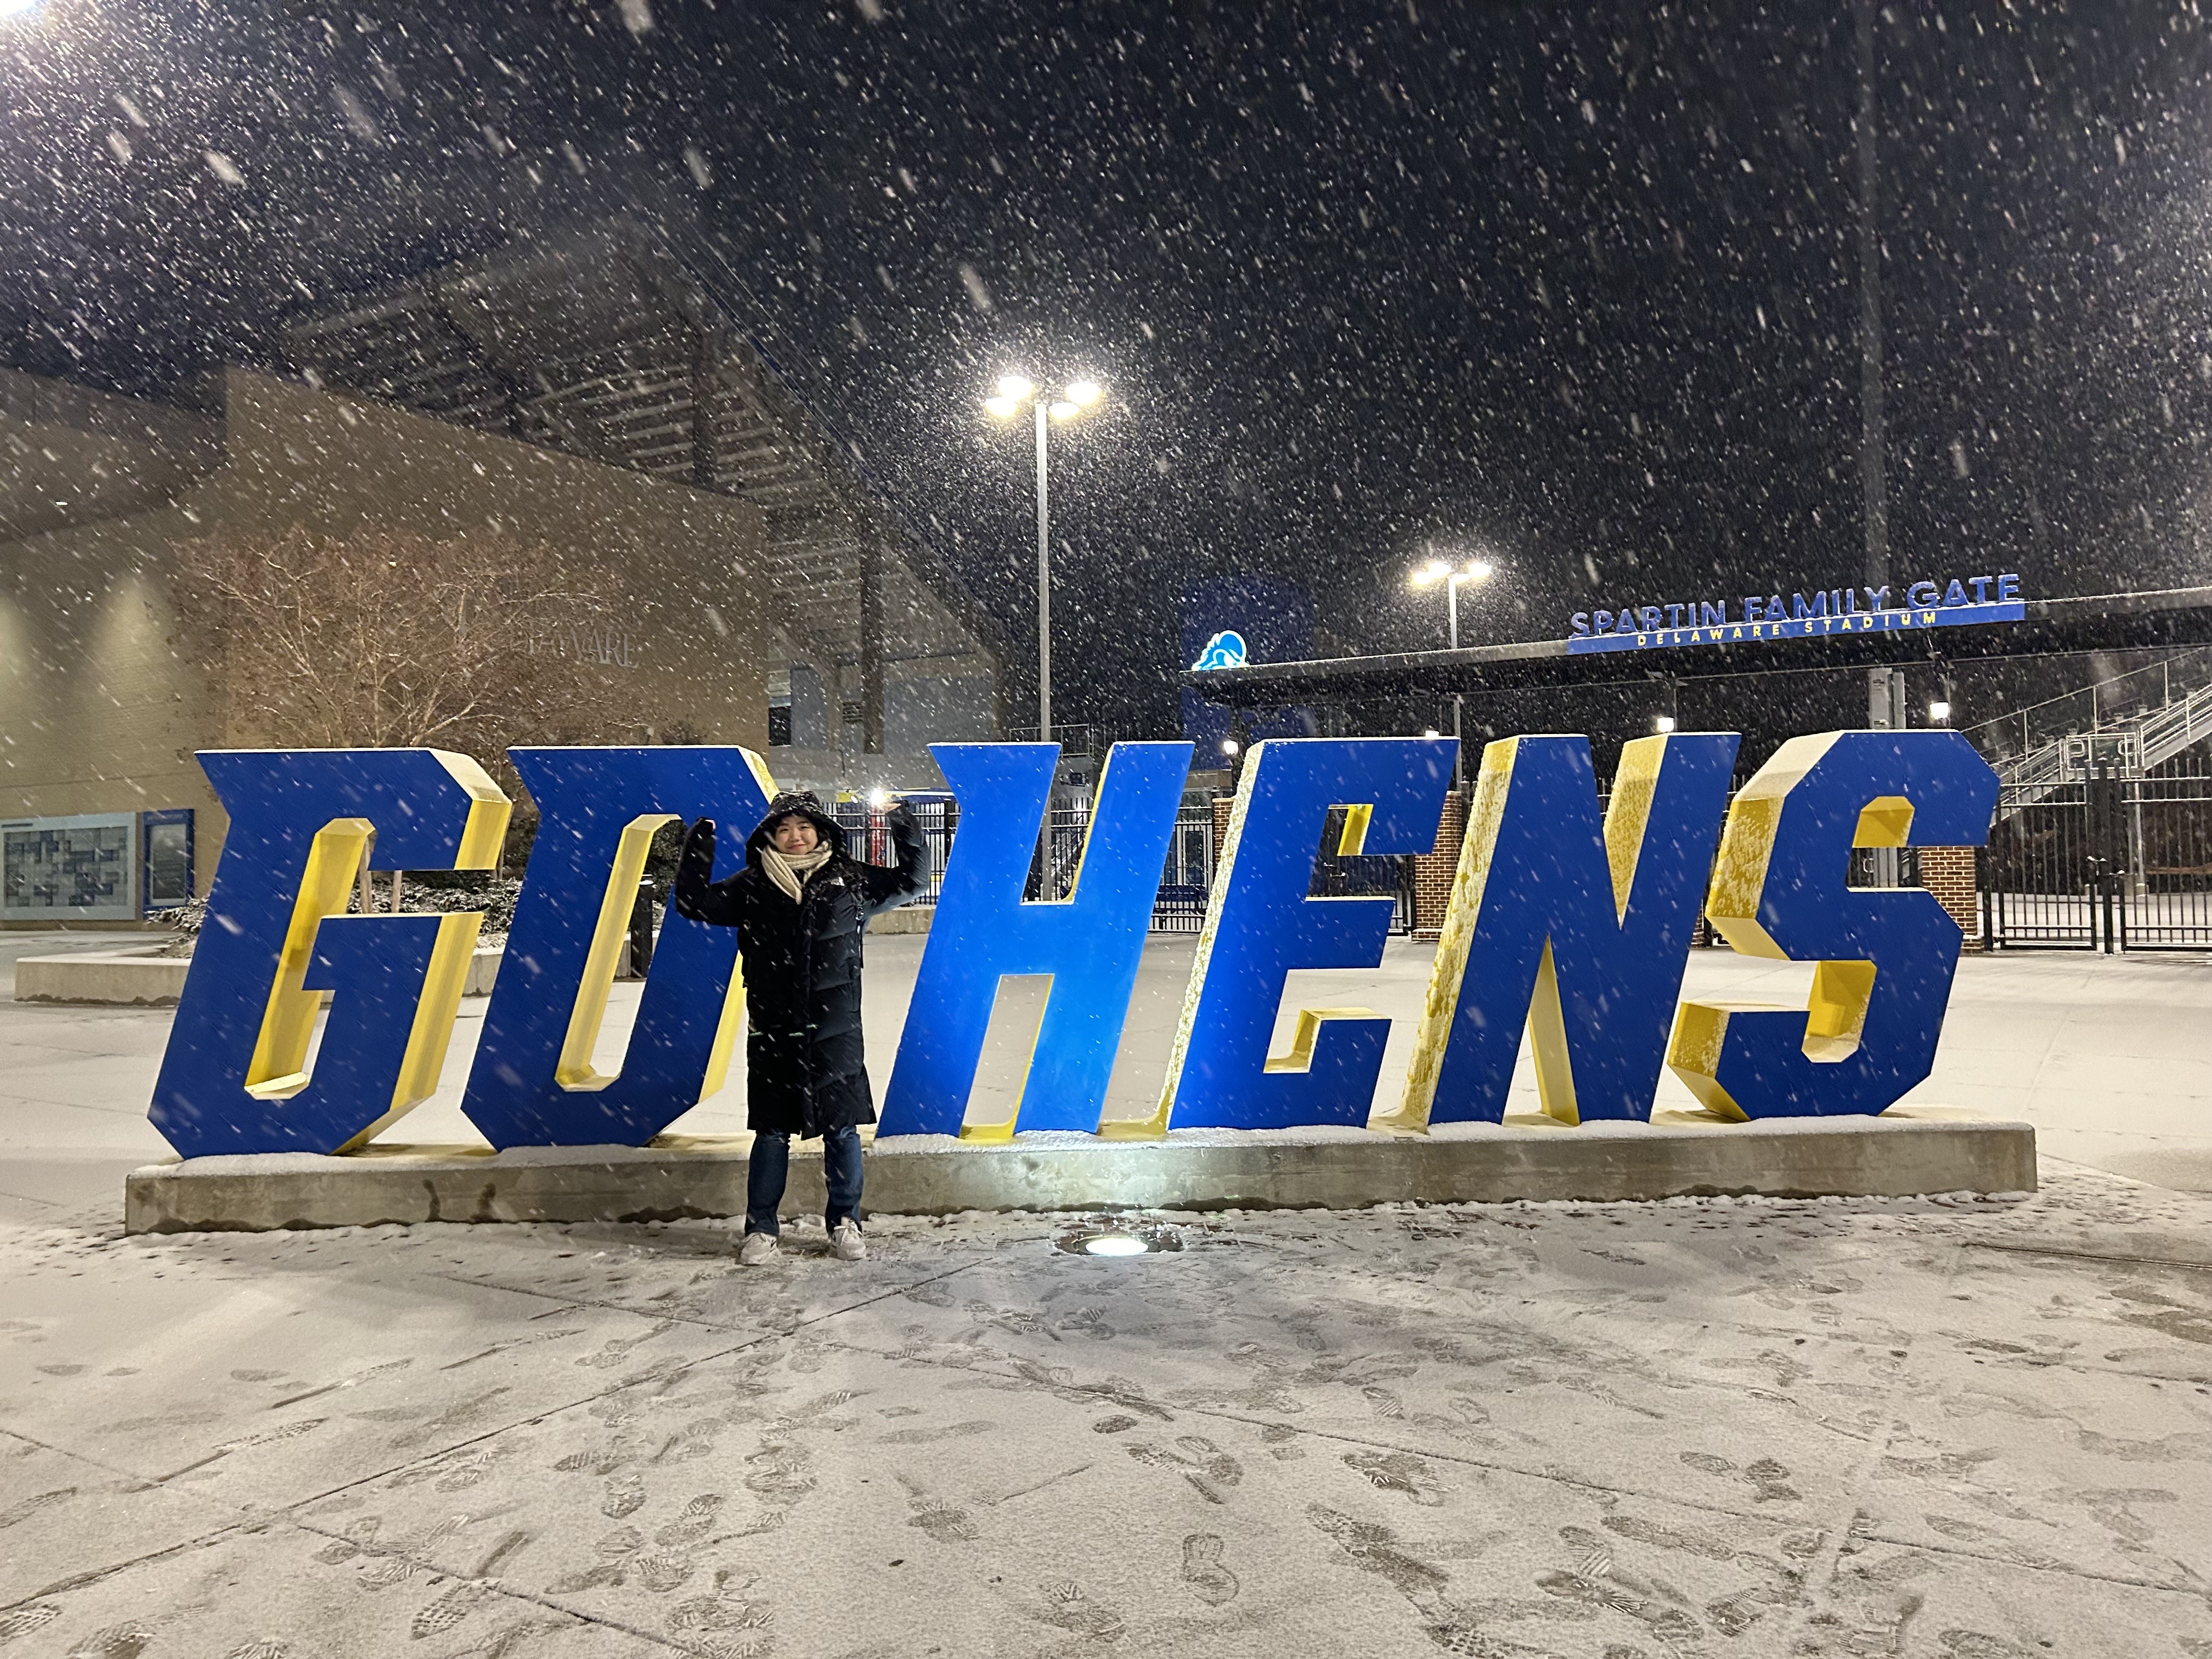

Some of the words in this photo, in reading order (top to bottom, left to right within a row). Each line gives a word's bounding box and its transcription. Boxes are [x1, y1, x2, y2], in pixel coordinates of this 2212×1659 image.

[1569, 600, 1726, 639] SPARTIN
[1745, 585, 1889, 624] FAMILY
[1906, 573, 2024, 610] GATE
[1637, 623, 1780, 647] DELAWARE
[1804, 611, 1936, 633] STADIUM
[148, 744, 778, 1159] GO
[876, 729, 2000, 1138] HENS
